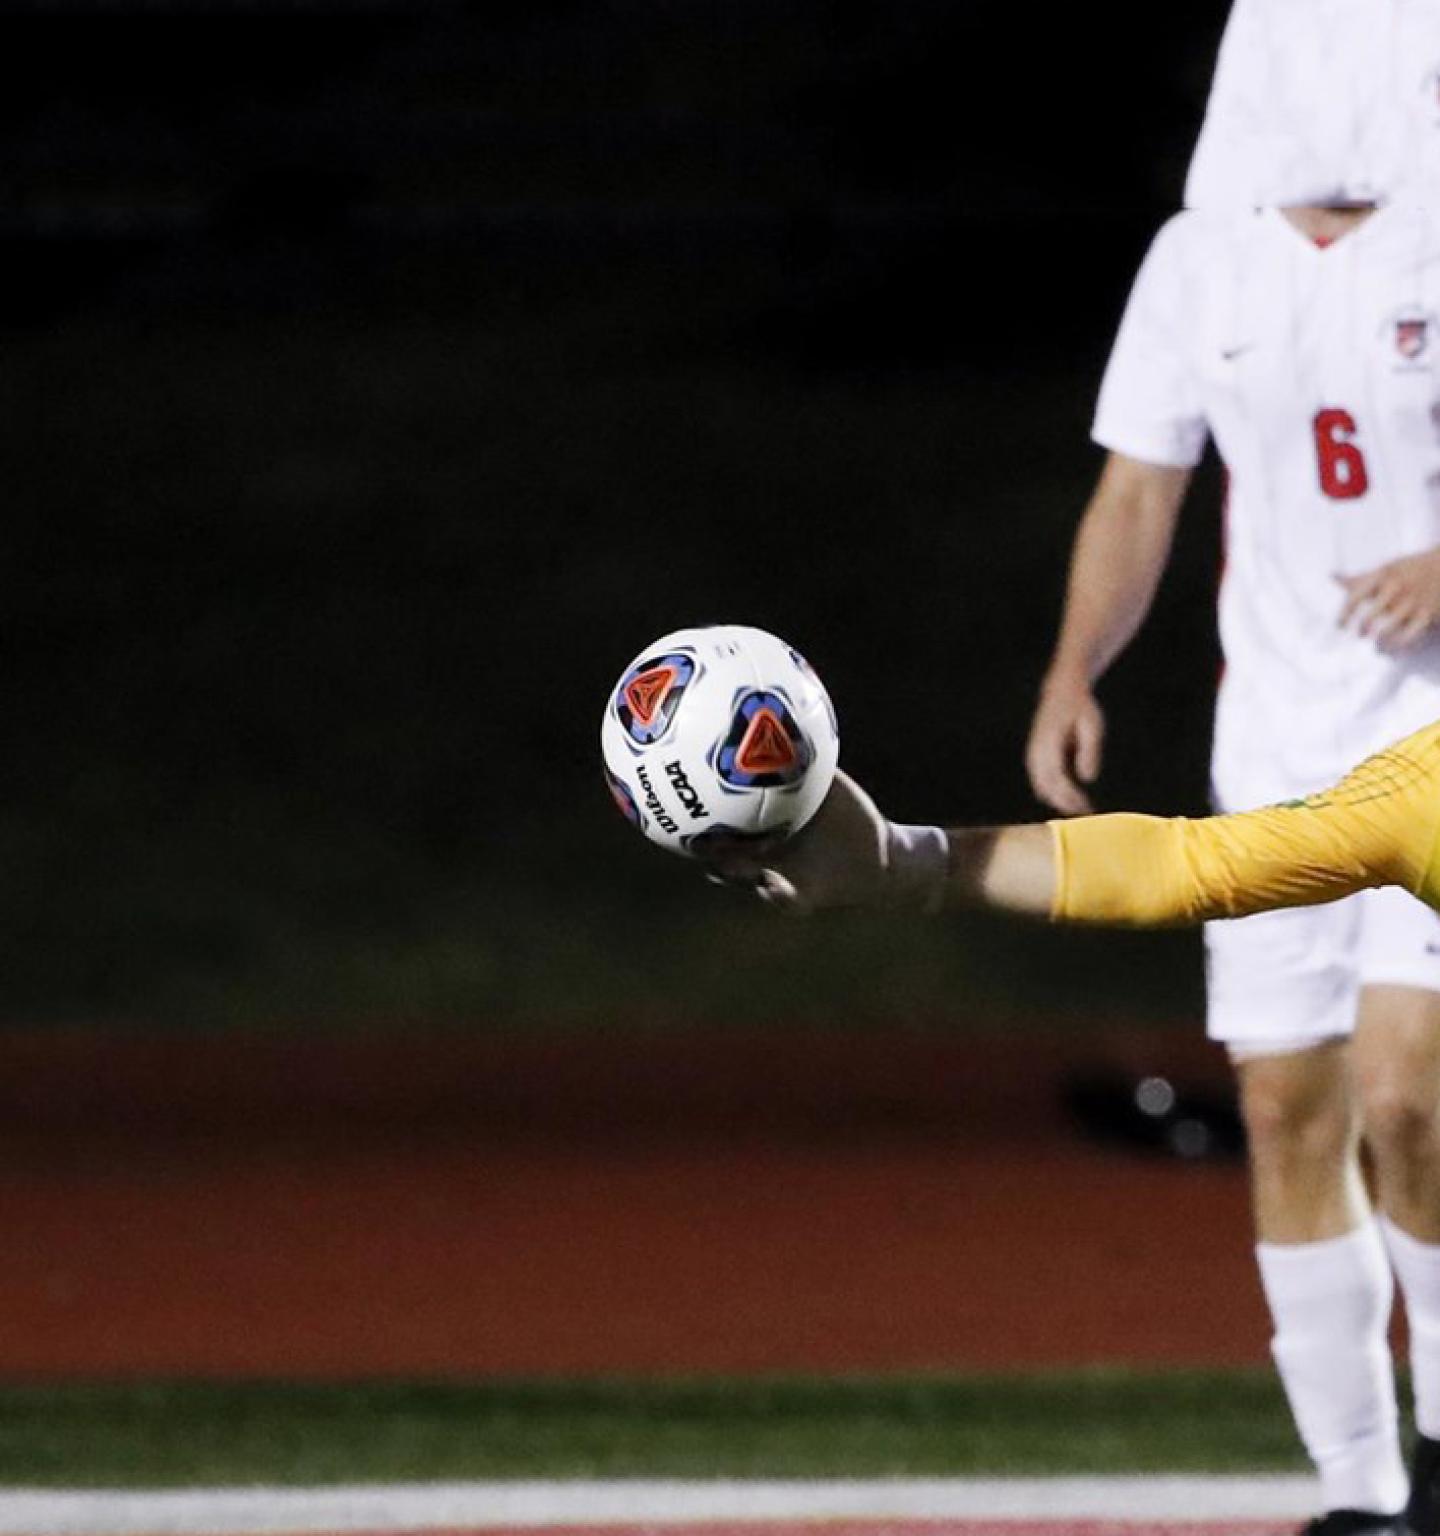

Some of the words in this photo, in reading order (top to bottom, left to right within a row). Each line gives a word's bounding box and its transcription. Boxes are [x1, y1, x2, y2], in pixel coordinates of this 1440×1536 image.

[1313, 407, 1368, 499] 6
[636, 764, 680, 834] Wilson
[665, 760, 710, 818] NCAA
